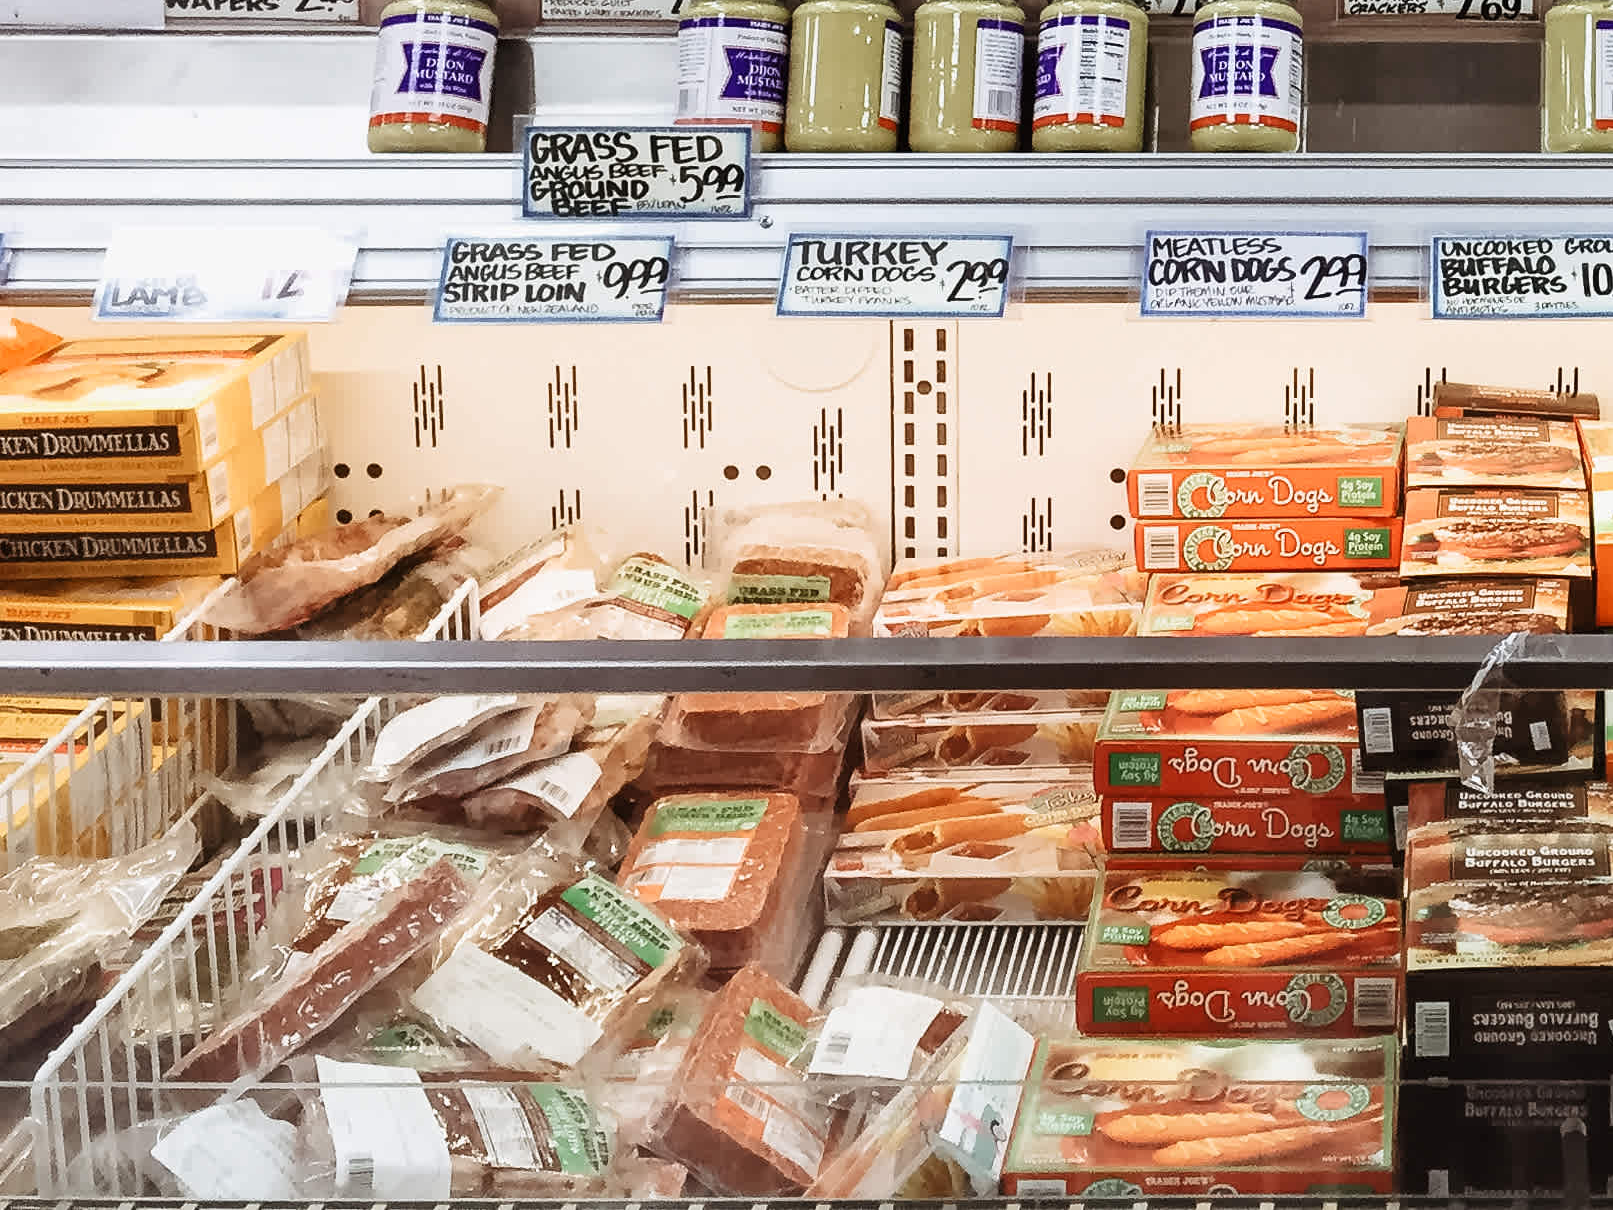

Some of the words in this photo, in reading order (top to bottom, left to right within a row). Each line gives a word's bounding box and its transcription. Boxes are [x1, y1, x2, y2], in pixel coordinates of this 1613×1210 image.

[1350, 1, 1428, 14] CRACKERS
[530, 132, 639, 165] GRASS
[649, 134, 724, 165] FED
[530, 165, 604, 180] ANGUS
[608, 163, 670, 179] BEEF
[531, 179, 649, 200] GROUND
[553, 197, 636, 216] BEEF
[451, 241, 543, 264] GRASS
[551, 243, 616, 262] FED
[791, 240, 948, 266] TURKEY
[1153, 237, 1282, 257] MEATLESS
[1441, 240, 1553, 257] UNCOOKED
[448, 264, 522, 282] ANGUS
[525, 262, 581, 280] BEEF
[797, 266, 864, 283] CORN
[872, 266, 936, 282] DOGS
[1149, 257, 1226, 286] CORN
[1231, 256, 1297, 283] DOGS
[1441, 255, 1556, 278] BUFFALO
[443, 283, 520, 302] STRIP
[525, 282, 587, 302] LOIN
[1442, 276, 1568, 297] BURGERS
[1206, 476, 1264, 506] Corn
[1269, 475, 1334, 512] Dogs
[1347, 541, 1384, 552] Protein
[1360, 532, 1381, 544] Soy
